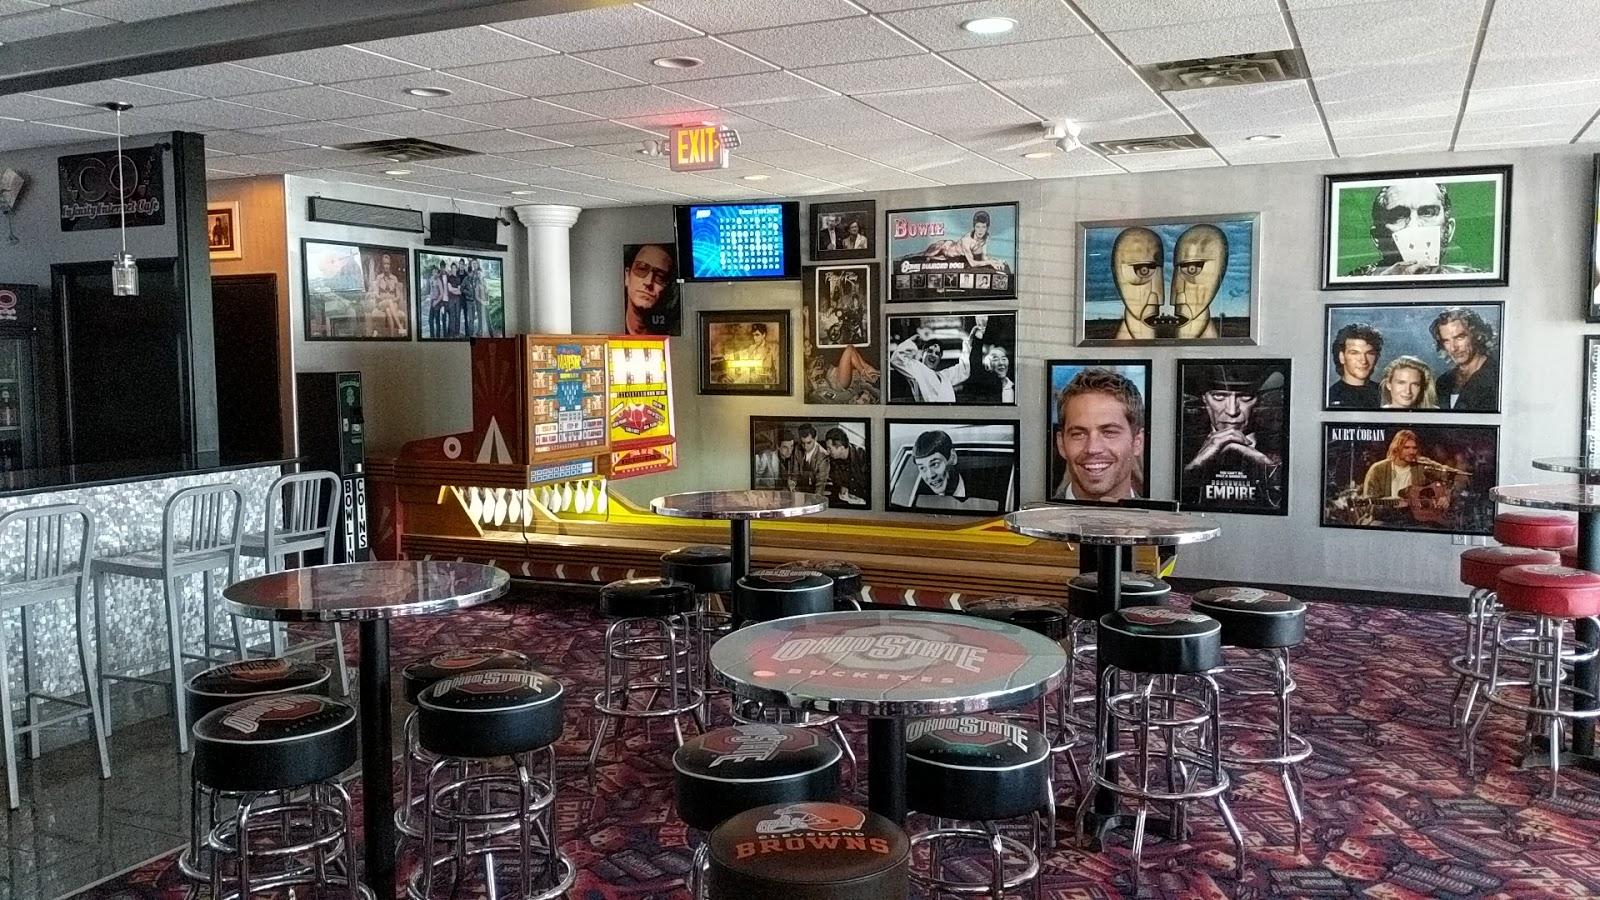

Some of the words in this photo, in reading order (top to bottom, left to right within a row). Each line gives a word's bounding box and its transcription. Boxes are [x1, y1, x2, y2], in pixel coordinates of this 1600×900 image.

[677, 127, 716, 164] EXIT
[651, 315, 665, 325] U2
[1332, 428, 1355, 440] KURT
[1356, 428, 1386, 441] COBAIN
[1205, 485, 1257, 500] EMPIRE
[357, 479, 367, 547] COINS
[771, 635, 871, 662] OHIO
[868, 634, 989, 674] STATE
[787, 668, 956, 684] BUCKEYES
[758, 831, 865, 840] CLEVELAND
[735, 836, 890, 860] BROWNS
